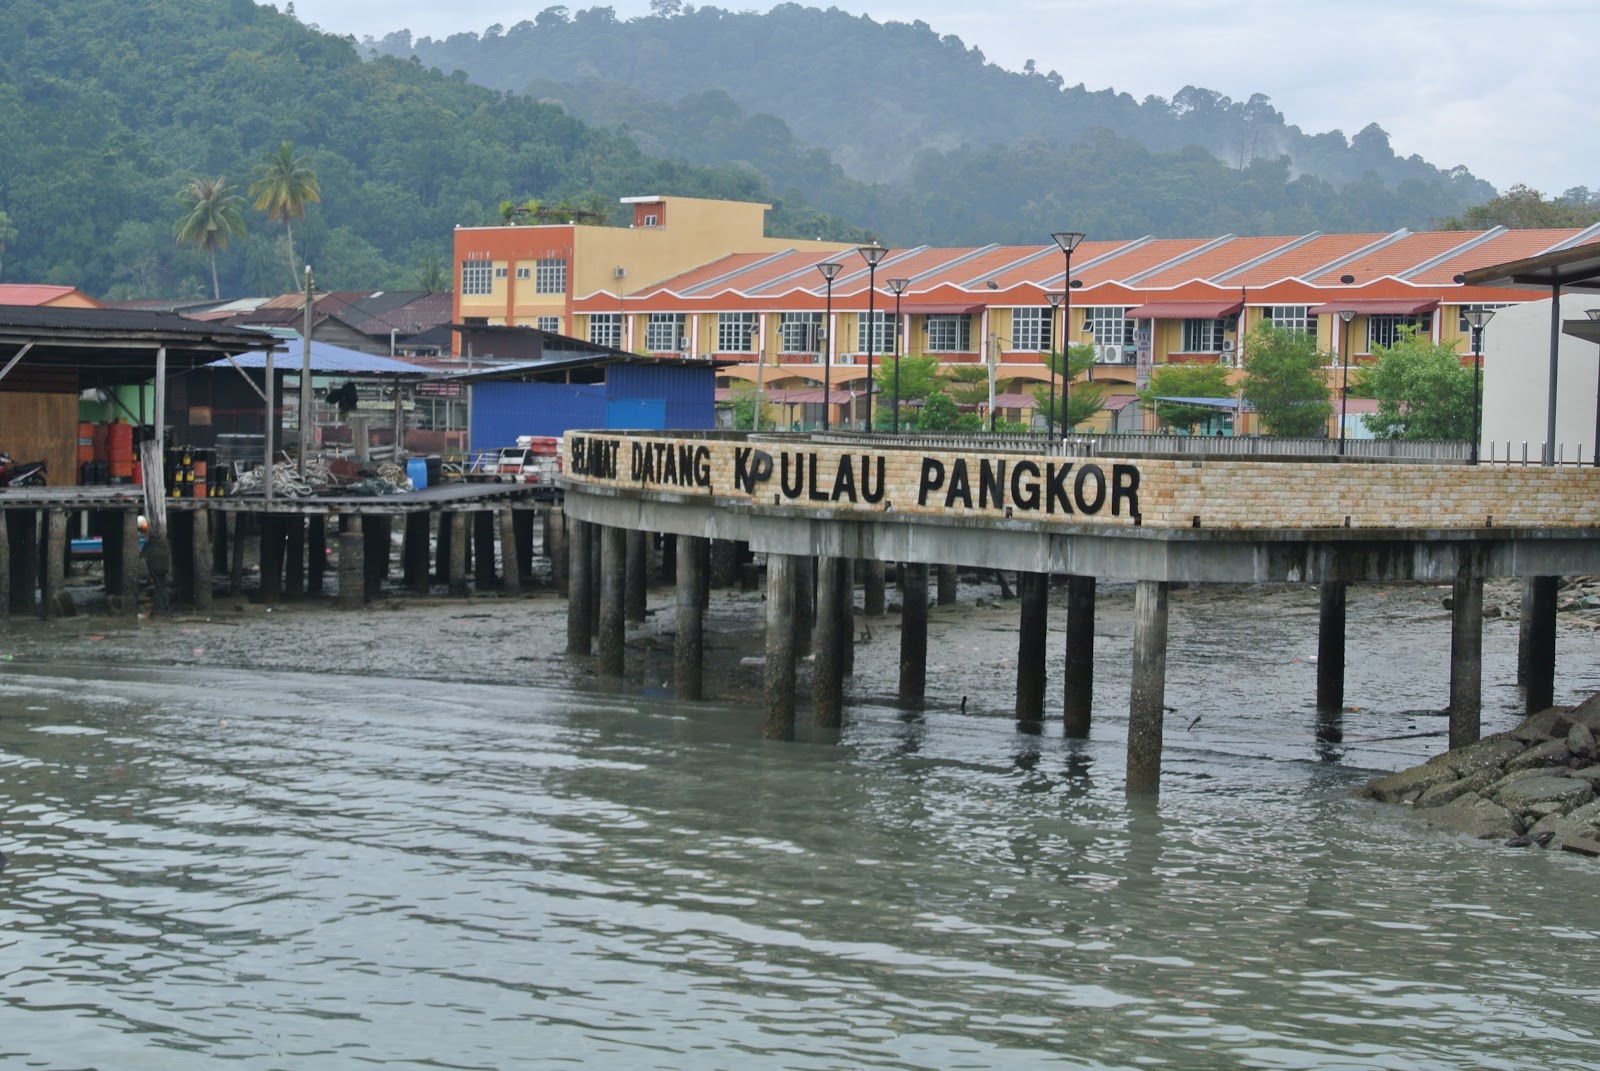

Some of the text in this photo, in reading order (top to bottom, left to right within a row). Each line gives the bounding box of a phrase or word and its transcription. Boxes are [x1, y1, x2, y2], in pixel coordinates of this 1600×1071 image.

[572, 437, 620, 480] SELAMAT
[631, 441, 711, 487] DATANG
[918, 457, 1140, 516] PANGKOR
